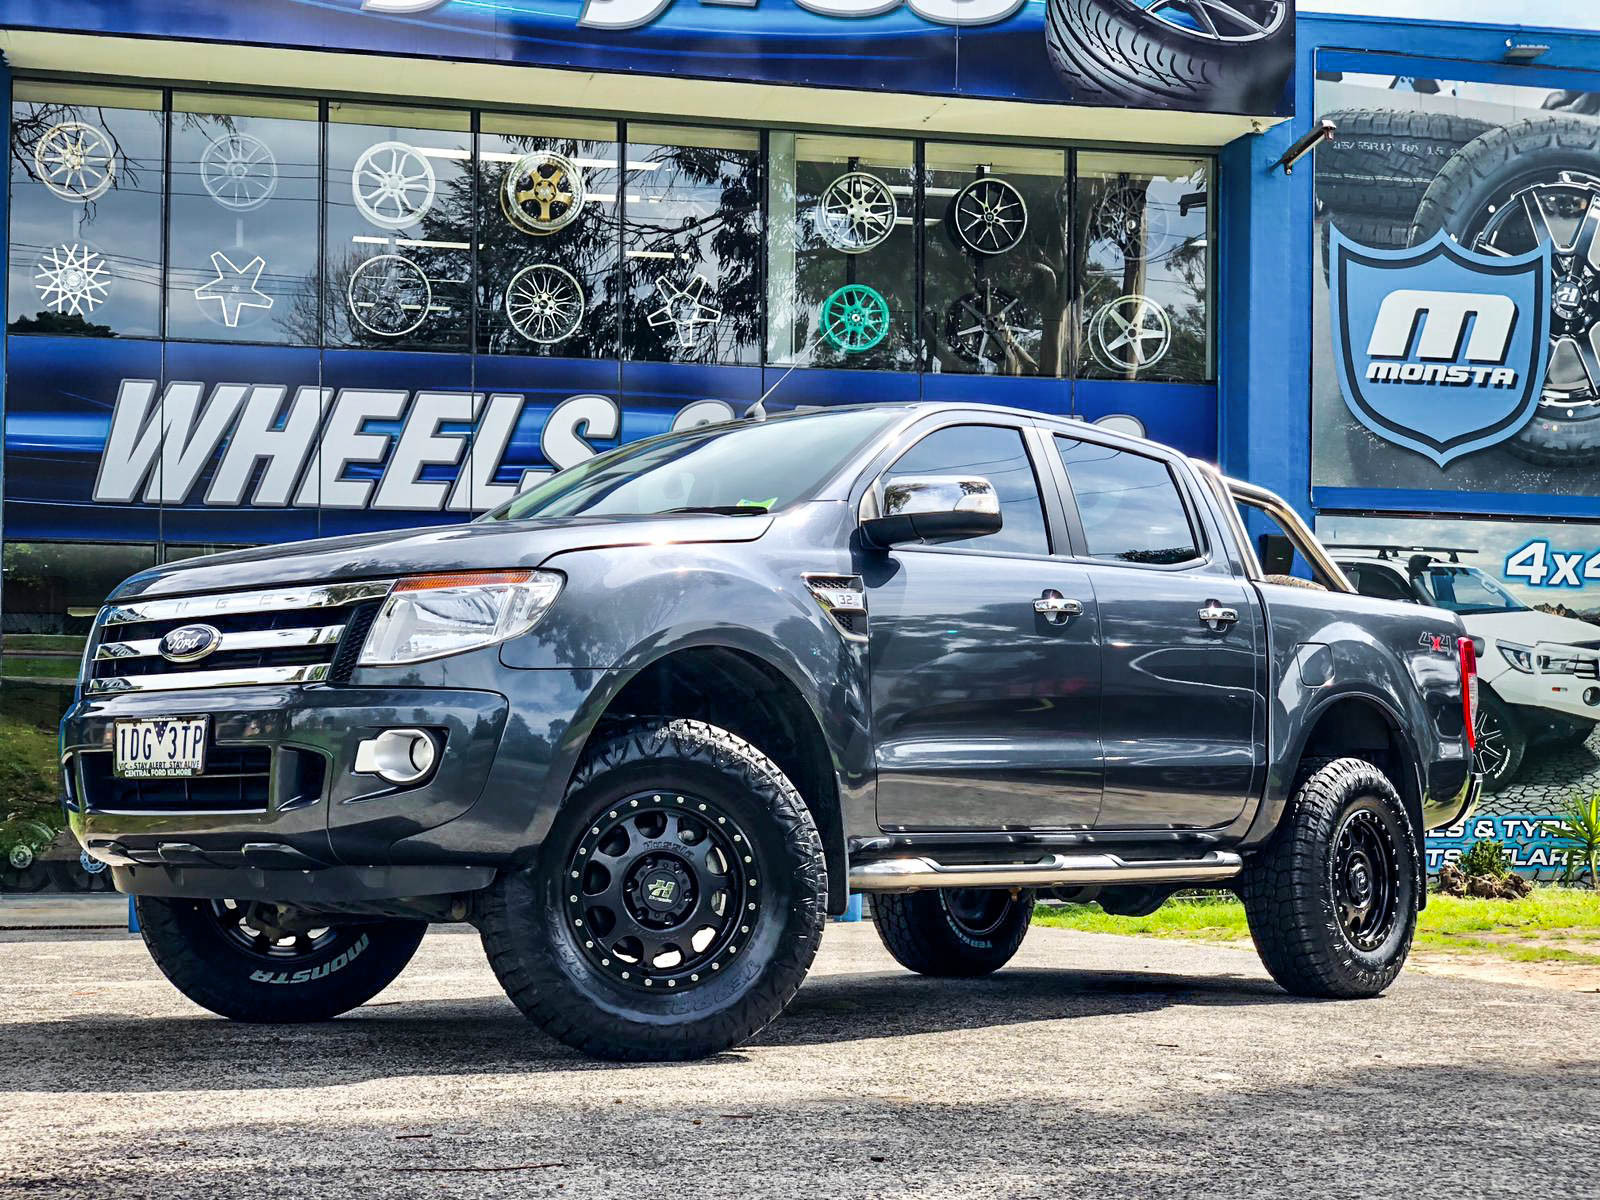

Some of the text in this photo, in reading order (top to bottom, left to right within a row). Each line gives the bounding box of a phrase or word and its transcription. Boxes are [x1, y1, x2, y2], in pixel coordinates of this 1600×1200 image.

[1365, 362, 1517, 388] MONSTA
[92, 378, 619, 511] WHEELS
[166, 630, 200, 650] Ford
[124, 768, 150, 777] CENTRAL
[151, 768, 167, 776] FORD
[169, 760, 183, 769] STAY
[184, 760, 200, 769] ALIVE
[1474, 820, 1496, 838] &
[1502, 820, 1593, 838] TYR
[1500, 848, 1600, 867] LAR
[249, 932, 370, 984] MONSTA
